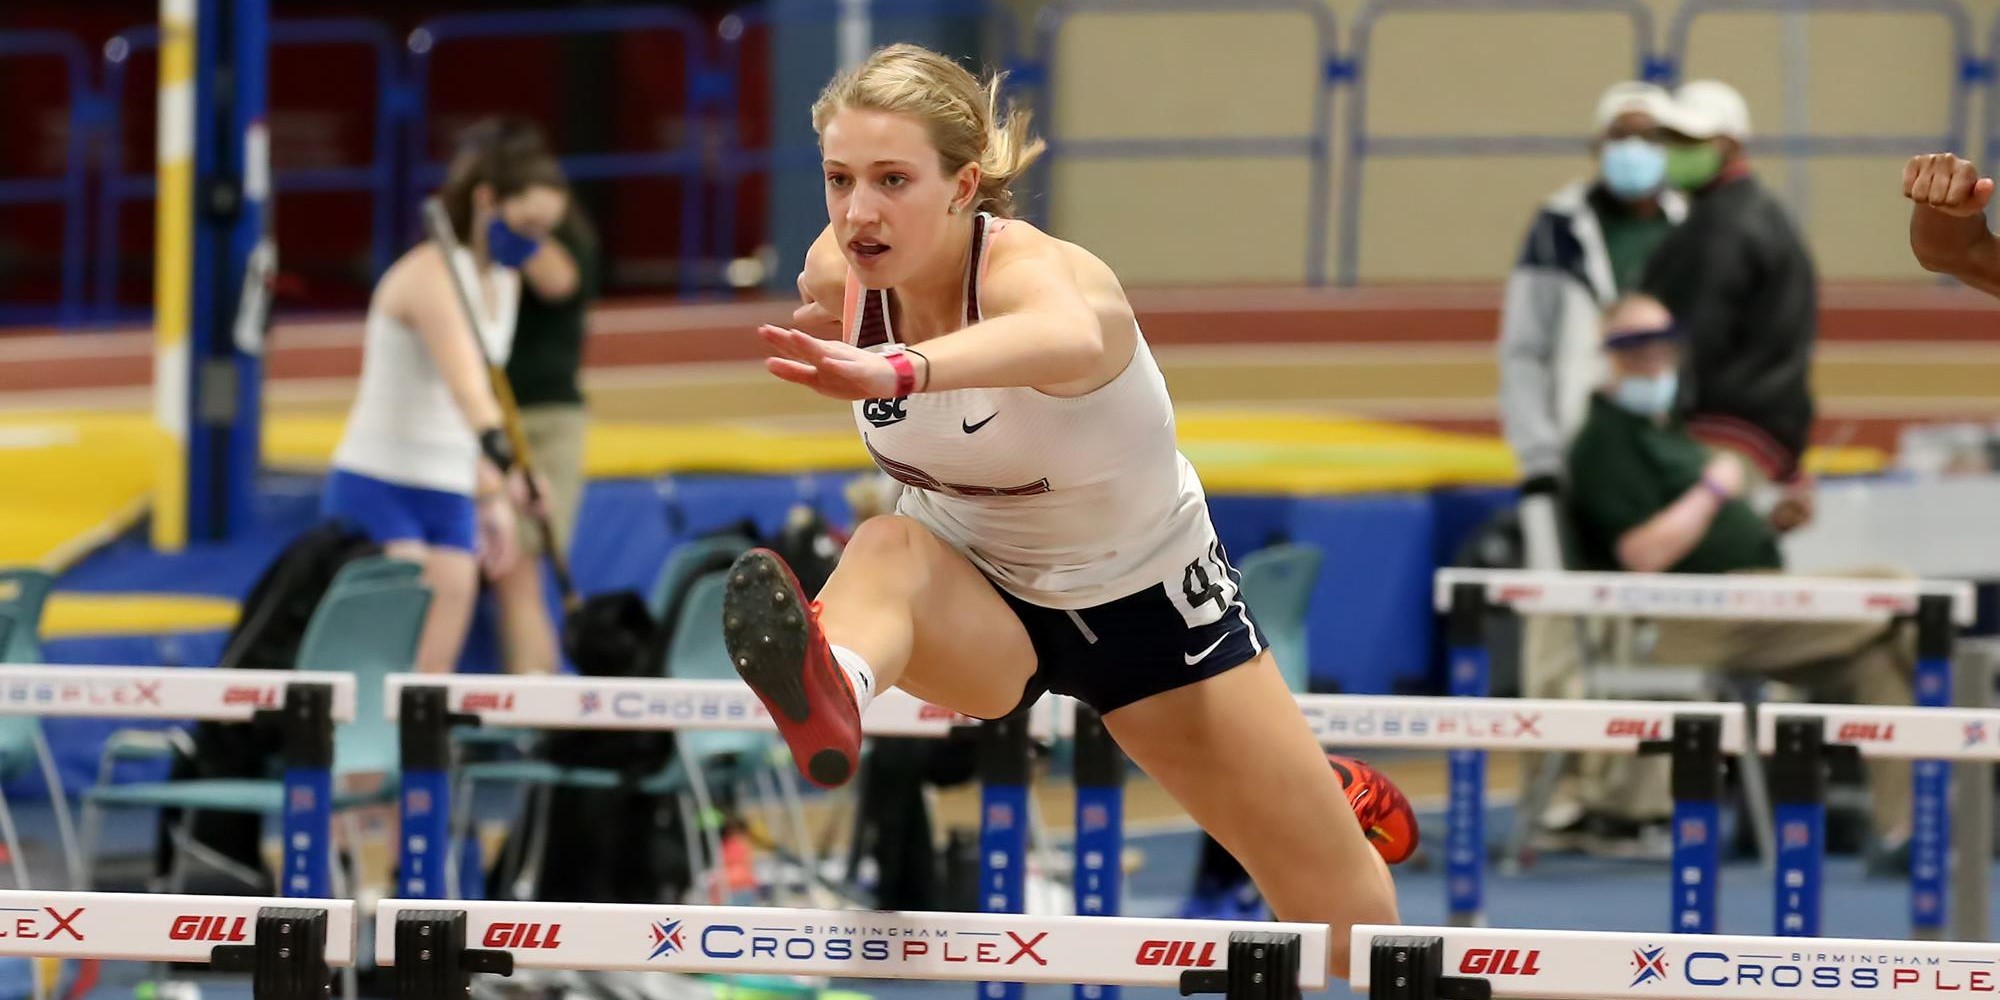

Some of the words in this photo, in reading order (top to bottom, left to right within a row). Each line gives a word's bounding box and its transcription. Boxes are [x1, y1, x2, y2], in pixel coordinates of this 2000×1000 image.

[1182, 557, 1228, 612] 4
[1604, 717, 1665, 738] GILL
[168, 915, 247, 942] GILL
[482, 922, 563, 949] GILL
[804, 924, 950, 938] BIRMINGHAM
[1135, 940, 1218, 968] GILL
[1459, 948, 1542, 976] GILL
[1791, 952, 1941, 966] BIRMINGHAM
[1684, 951, 2000, 993] CROSSPLE
